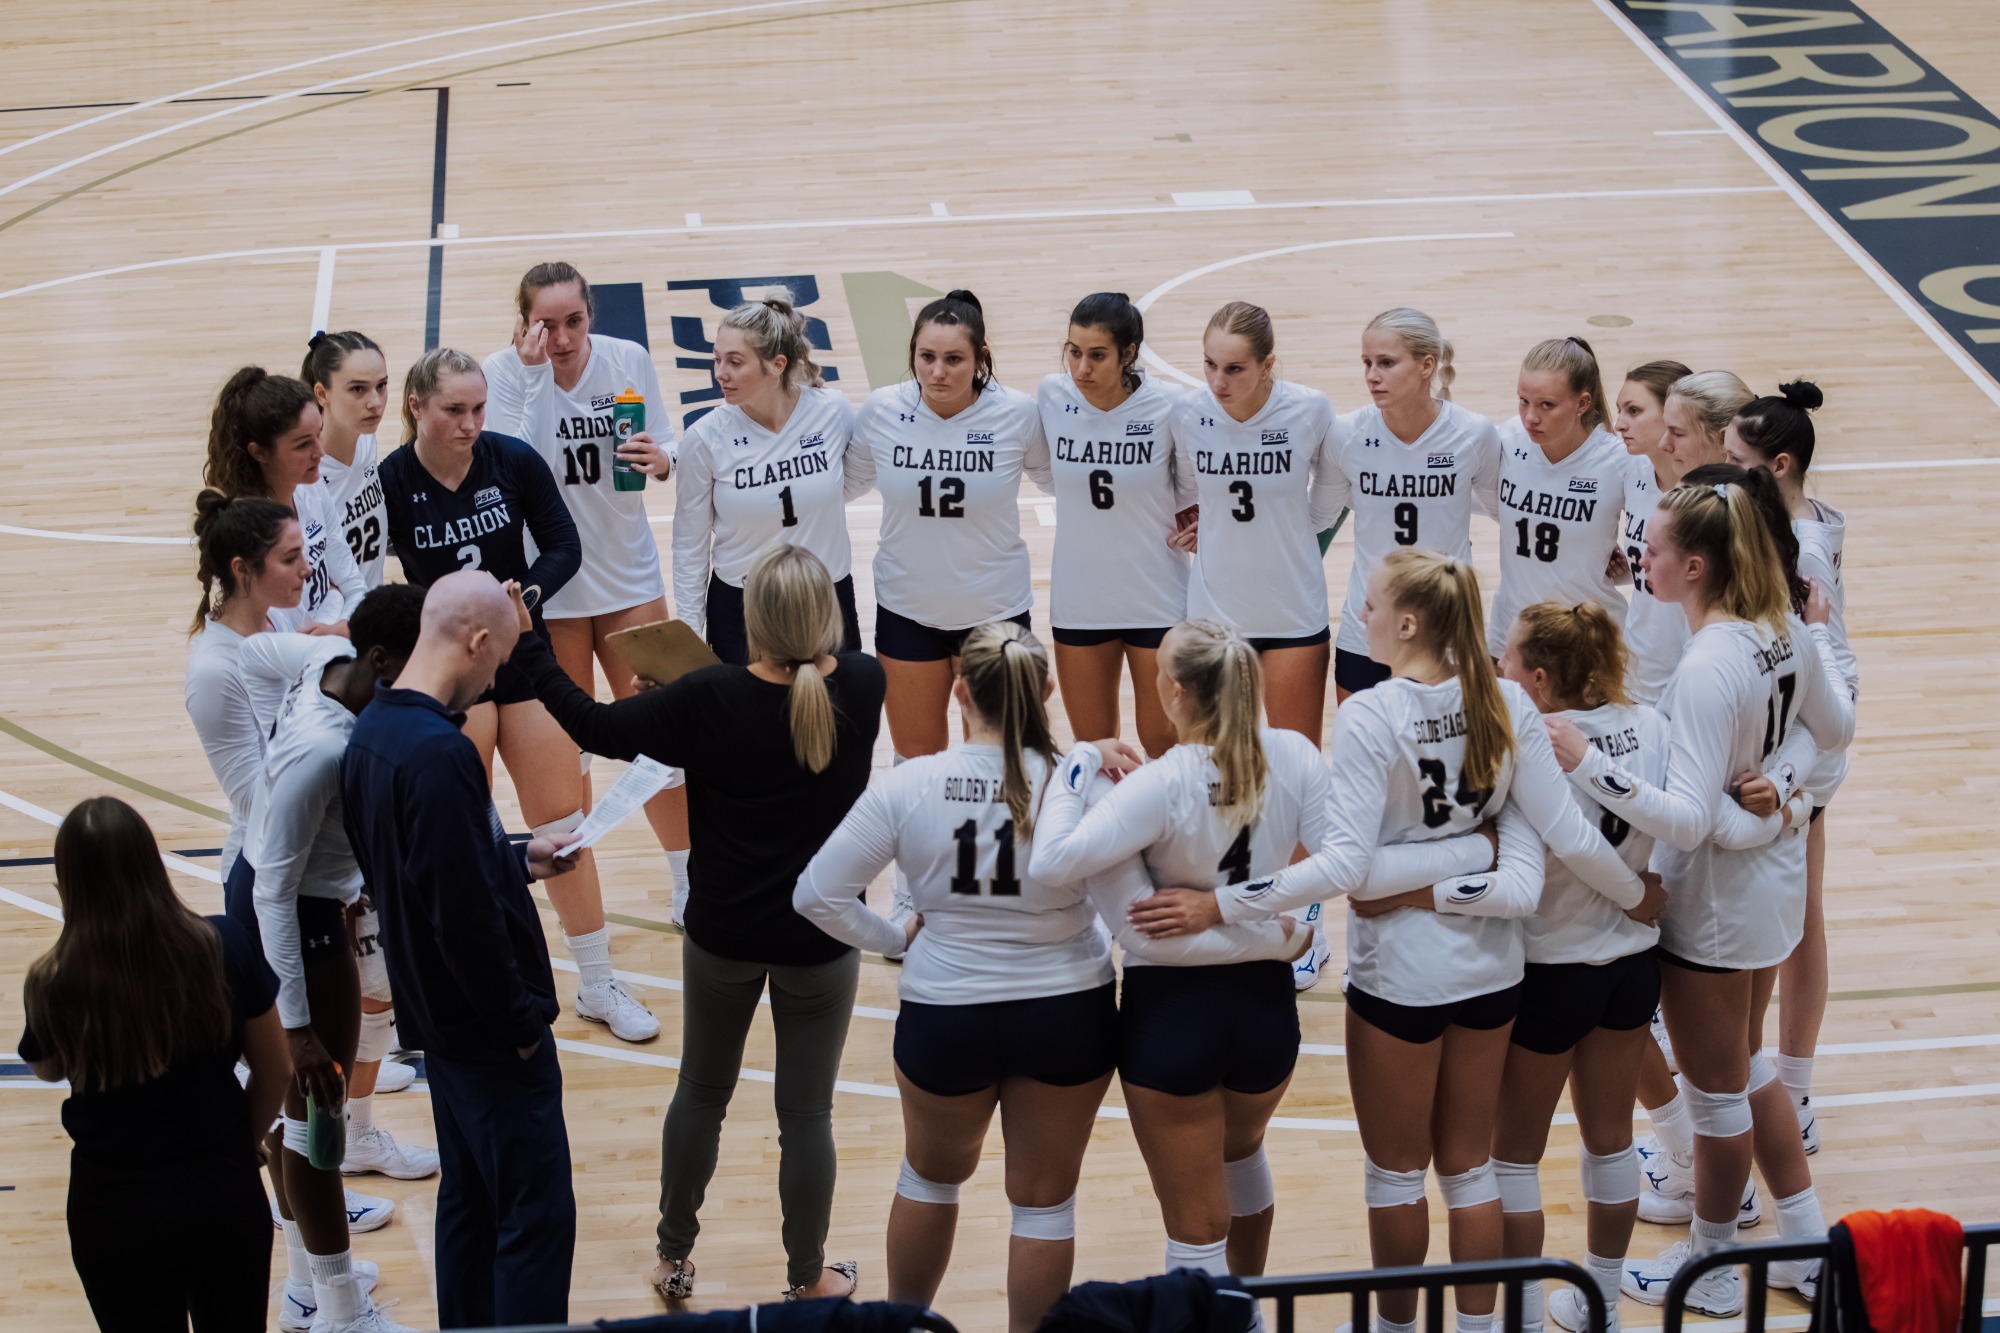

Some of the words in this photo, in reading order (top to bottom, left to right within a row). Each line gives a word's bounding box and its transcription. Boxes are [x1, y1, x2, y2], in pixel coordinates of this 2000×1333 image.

[556, 415, 614, 440] ARION
[800, 434, 824, 446] PSAC
[967, 433, 994, 441] PSAC
[1126, 423, 1155, 433] PSAC
[1261, 432, 1289, 442] PSAC
[563, 443, 602, 486] 10
[893, 445, 994, 472] CLARION
[1056, 436, 1155, 465] CLARION
[1196, 449, 1293, 476] CLARION
[1427, 455, 1455, 465] PSAC
[734, 451, 829, 490] CLARION
[1089, 469, 1115, 510] 6
[1359, 471, 1457, 498] CLARION
[1568, 479, 1599, 490] PSAC
[341, 478, 385, 527] ARION
[475, 489, 501, 502] PSAC
[778, 485, 798, 528] 1
[918, 475, 966, 518] 12
[1228, 480, 1256, 522] 3
[1500, 478, 1598, 523] CLARION
[306, 520, 321, 535] SAC
[346, 514, 381, 566] 22
[414, 503, 511, 549] CLARION
[1394, 502, 1419, 546] 9
[1514, 517, 1561, 563] 18
[1627, 545, 1654, 596] 2
[944, 777, 987, 803] GOLDEN
[950, 817, 1022, 897] 11
[1217, 822, 1252, 887] 4
